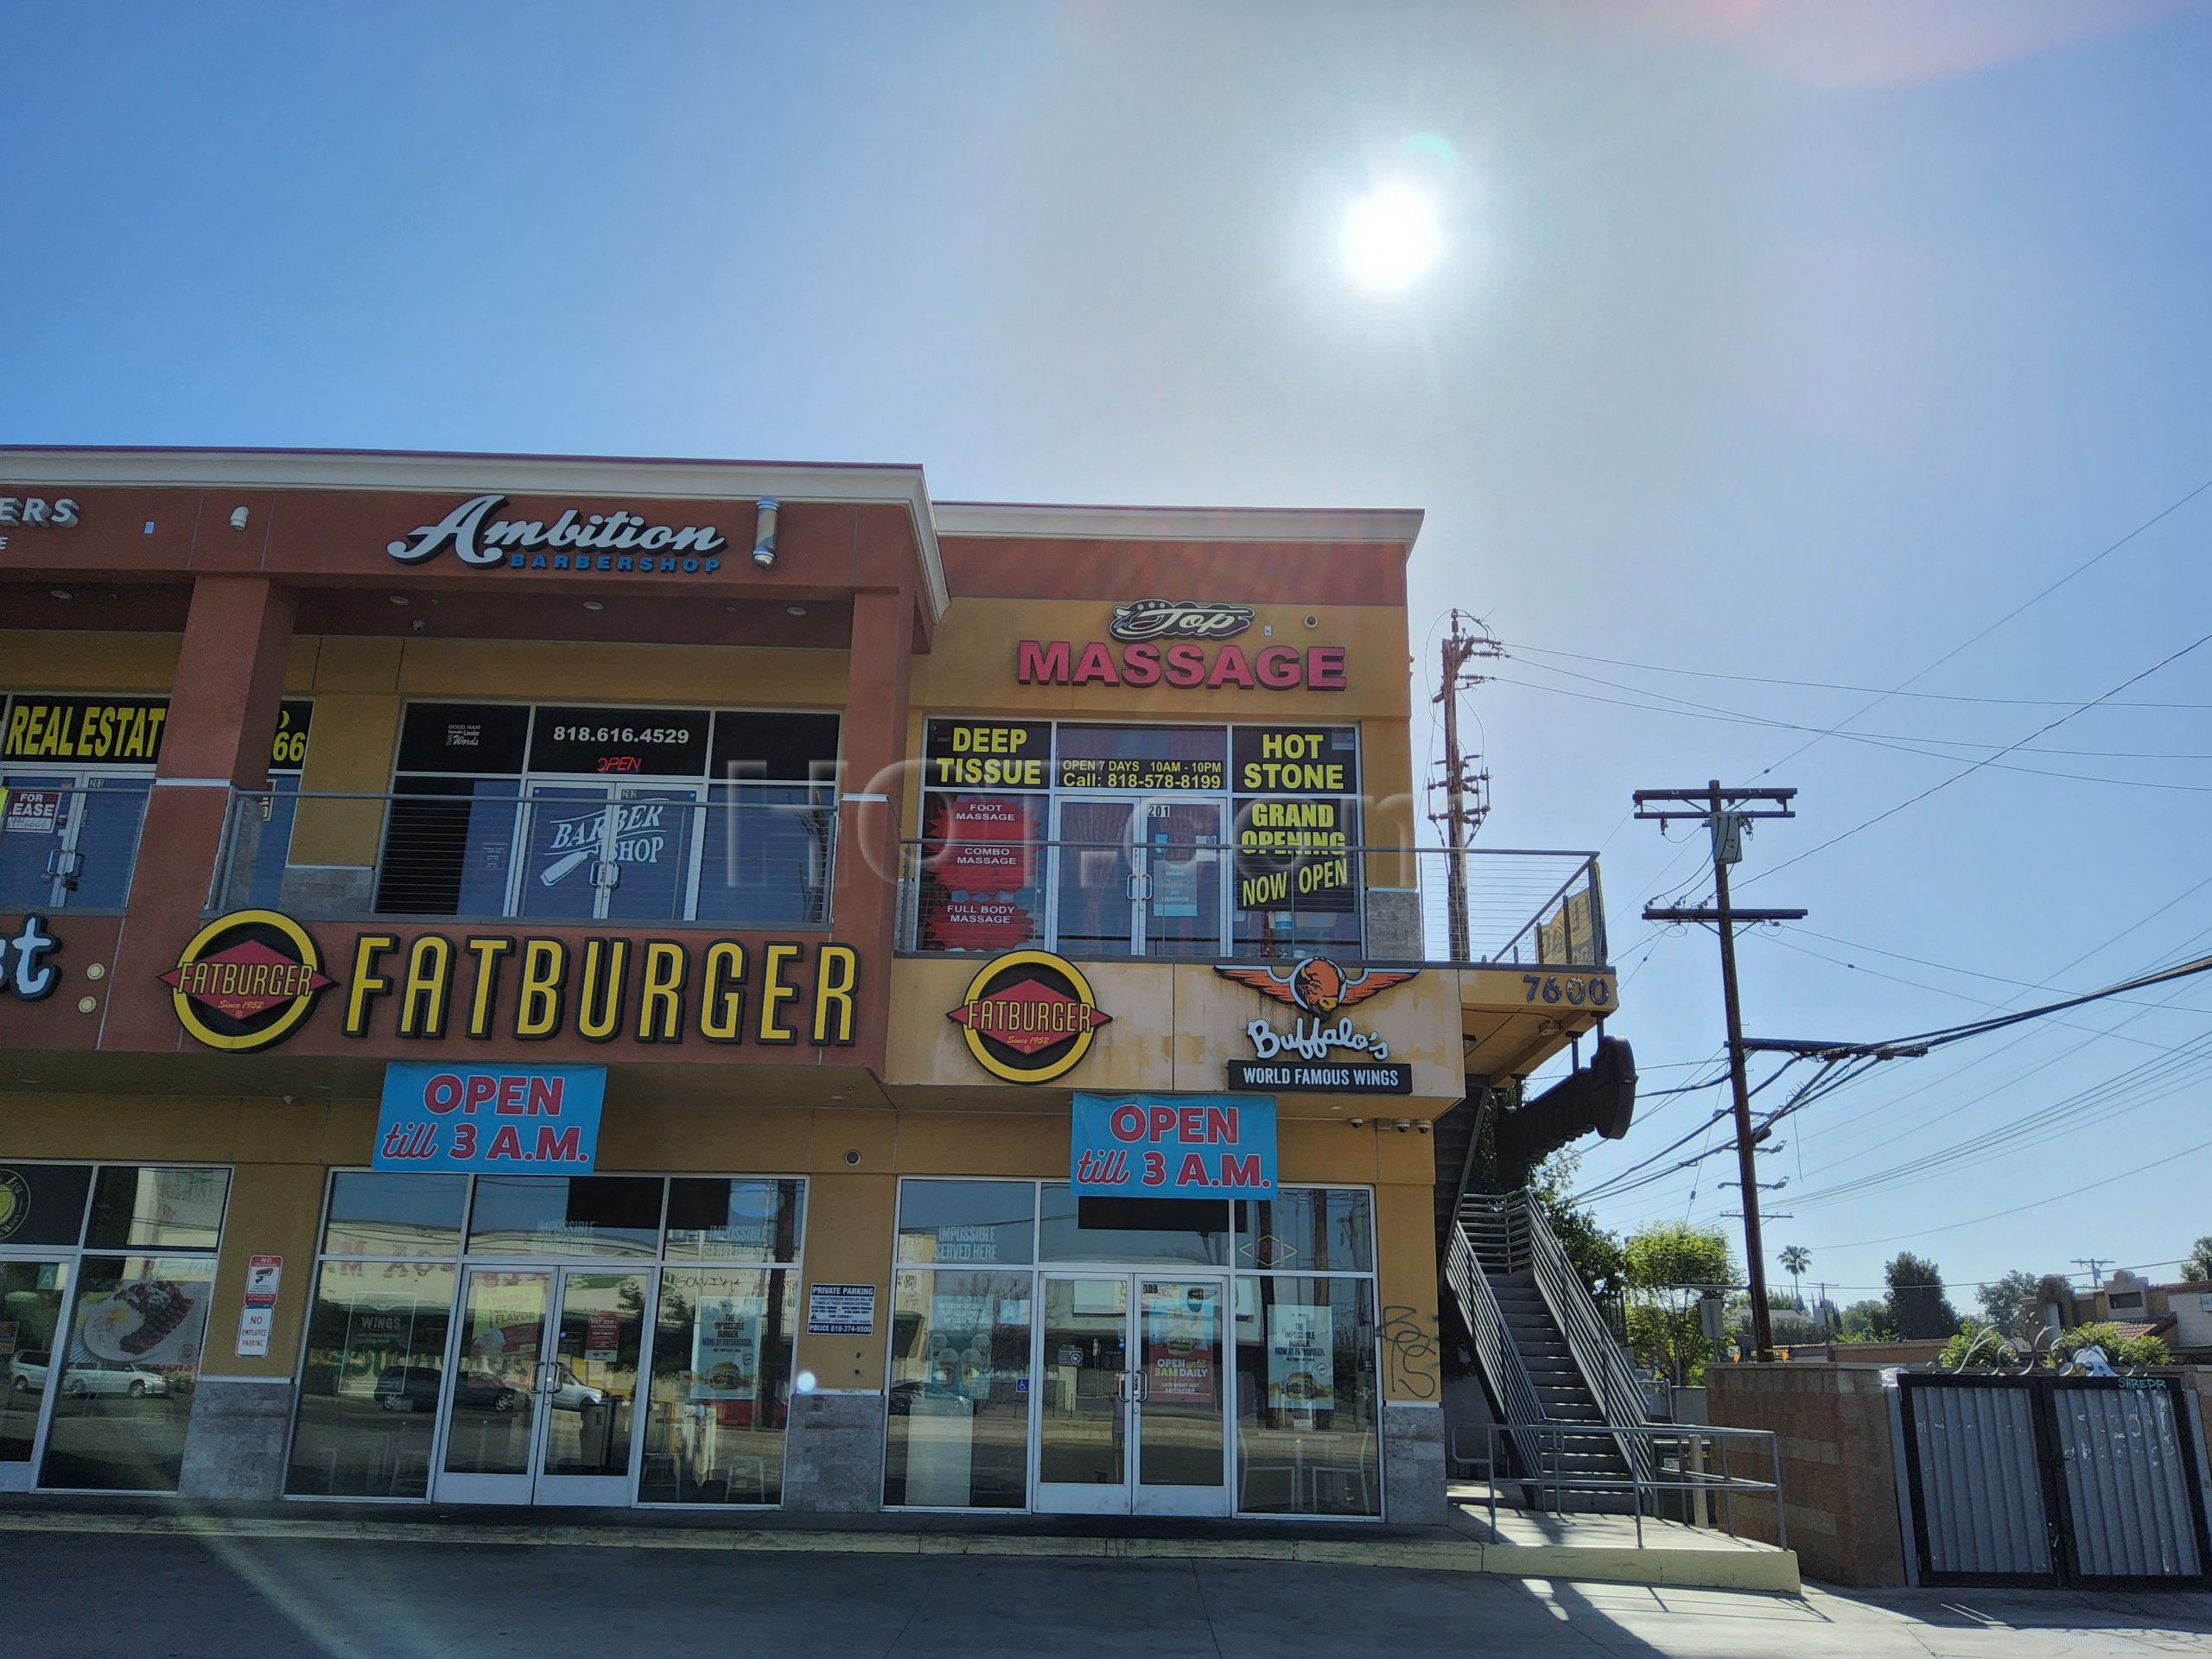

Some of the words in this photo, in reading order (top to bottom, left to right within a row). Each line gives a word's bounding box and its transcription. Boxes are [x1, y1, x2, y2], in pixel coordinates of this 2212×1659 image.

[386, 493, 727, 569] Ambition
[510, 553, 721, 574] BARBERSHOP
[1120, 607, 1253, 635] Top
[1019, 639, 1347, 690] MASSAGE
[5, 705, 77, 756] REAL
[553, 726, 690, 744] 818.616.4529
[952, 727, 1028, 753] DEEP
[1262, 734, 1324, 760] HOT
[596, 756, 642, 772] OPEN
[936, 757, 1042, 786] TISSUE
[1062, 760, 1096, 772] OPEN
[1098, 760, 1105, 772] 7
[1109, 760, 1140, 772] DAYS
[1150, 761, 1180, 773] 10AM
[1191, 761, 1222, 773] 10PM
[1062, 772, 1102, 788] Call:
[1107, 773, 1222, 790] 818-578-8199
[1243, 763, 1344, 790] STONE
[20, 793, 44, 804] FOR
[622, 789, 638, 799] 202
[9, 802, 55, 817] EASE
[956, 812, 1015, 821] MASSAGE
[1148, 805, 1168, 817] 201
[1251, 803, 1334, 828] GRAND
[1241, 831, 1346, 856] OPENING
[957, 856, 1016, 865] MASSAGE
[1243, 871, 1287, 907] NOW
[1299, 858, 1348, 893] OPEN
[947, 905, 977, 913] FULL
[981, 906, 1015, 914] BODY
[950, 914, 1011, 924] MASSAGE
[177, 962, 314, 996] FATBURGER
[343, 934, 859, 1045] FATBURGER
[1522, 974, 1609, 1006] 7600
[219, 1000, 241, 1009] Since
[243, 1001, 264, 1009] 1952
[967, 999, 1091, 1033] FATBURGER
[1007, 1035, 1029, 1044] Since
[1248, 1016, 1389, 1061] Buffalo's
[1243, 1066, 1290, 1084] WORLD
[1294, 1068, 1350, 1085] FAMOUS
[1353, 1069, 1399, 1086] WINGS
[423, 1073, 566, 1116] OPEN
[1109, 1104, 1239, 1145] OPEN
[380, 1122, 438, 1160] till
[448, 1122, 478, 1160] 3
[485, 1124, 589, 1163] A.M.
[1076, 1148, 1131, 1185] till
[1141, 1150, 1166, 1186] 3
[1174, 1152, 1272, 1189] A.M.
[938, 1226, 996, 1243] IMPOSSIBLE
[935, 1243, 971, 1260] SERVED
[973, 1244, 997, 1260] HERE
[361, 1316, 401, 1330] WINGS
[725, 1313, 734, 1322] THE
[1154, 1368, 1177, 1377] 3AM
[1179, 1369, 1208, 1378] DAILY
[1157, 1358, 1185, 1368] OPEN
[1186, 1360, 1207, 1369] until
